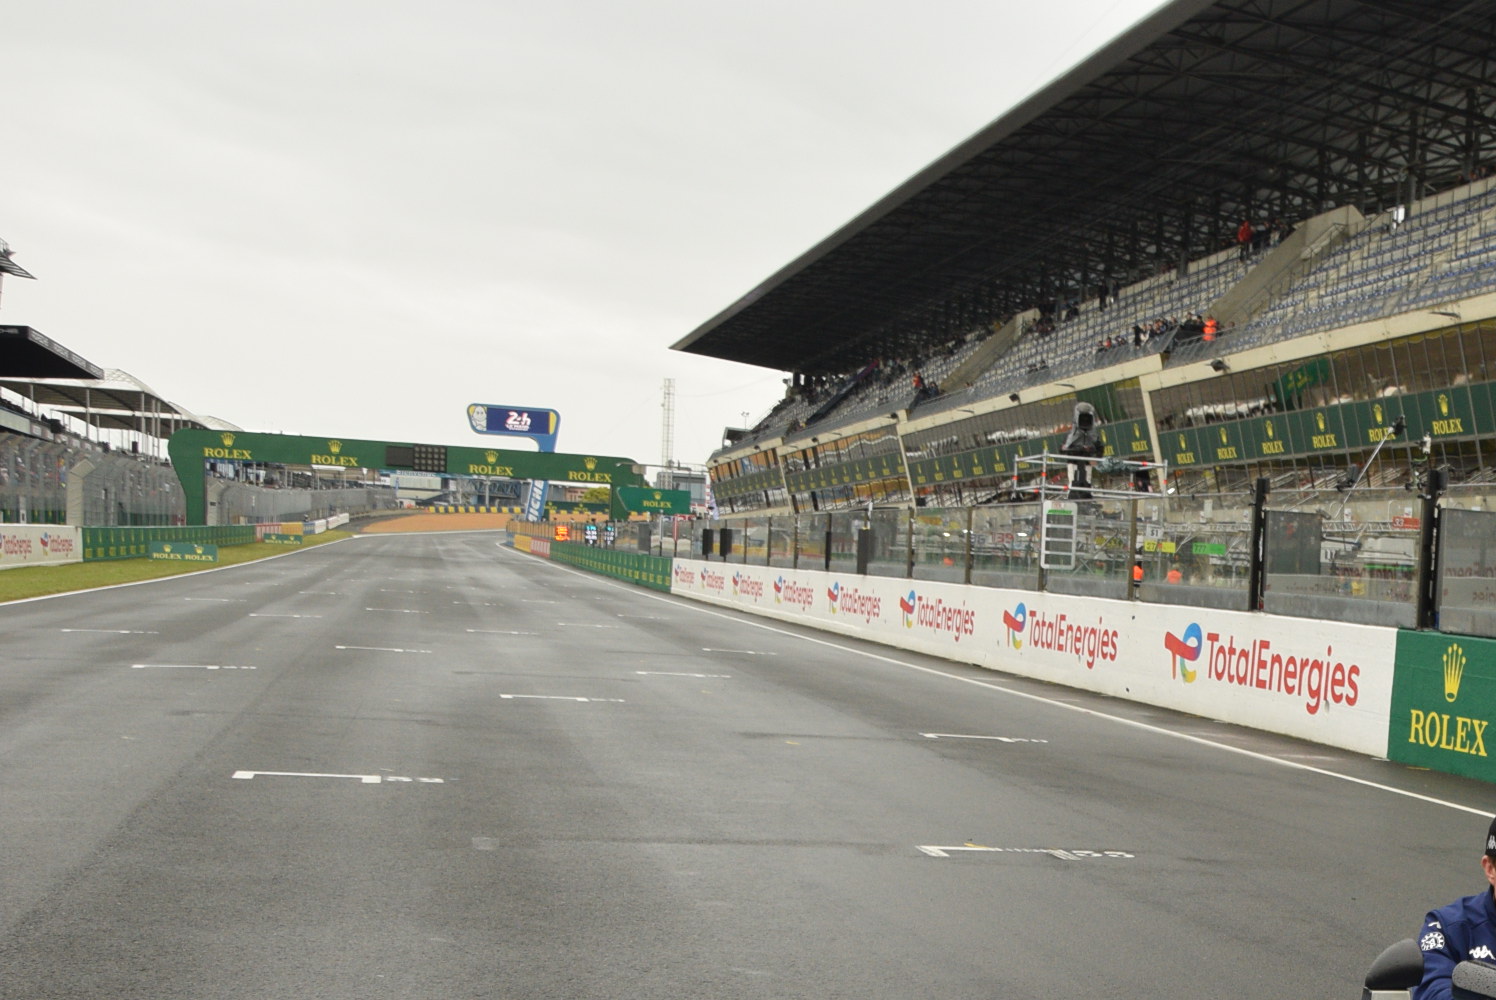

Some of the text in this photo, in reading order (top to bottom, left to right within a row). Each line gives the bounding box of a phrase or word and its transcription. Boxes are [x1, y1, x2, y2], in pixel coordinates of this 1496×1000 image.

[1432, 418, 1463, 435] ROLEX
[1262, 440, 1284, 454] ROLEX
[1311, 433, 1337, 449] ROLEX
[203, 447, 252, 460] ROLEX
[1176, 452, 1195, 464] ROLEX
[1217, 446, 1237, 460] ROLEX
[311, 454, 358, 467] ROLEX
[468, 463, 514, 477] ROLEX
[568, 471, 612, 483] ROLEX
[643, 500, 672, 509] ROLEX
[153, 552, 182, 560] ROLEX
[184, 553, 214, 561] ROLEX
[739, 576, 764, 602] TotalEnergies
[783, 578, 814, 611] TotalEnergies
[840, 586, 881, 623] TotalEnergies
[917, 595, 975, 642] TotalEnergies
[1029, 610, 1119, 670] TotalEnergies
[1206, 632, 1361, 716] TotalEnergies
[1408, 708, 1489, 757] ROLEX
